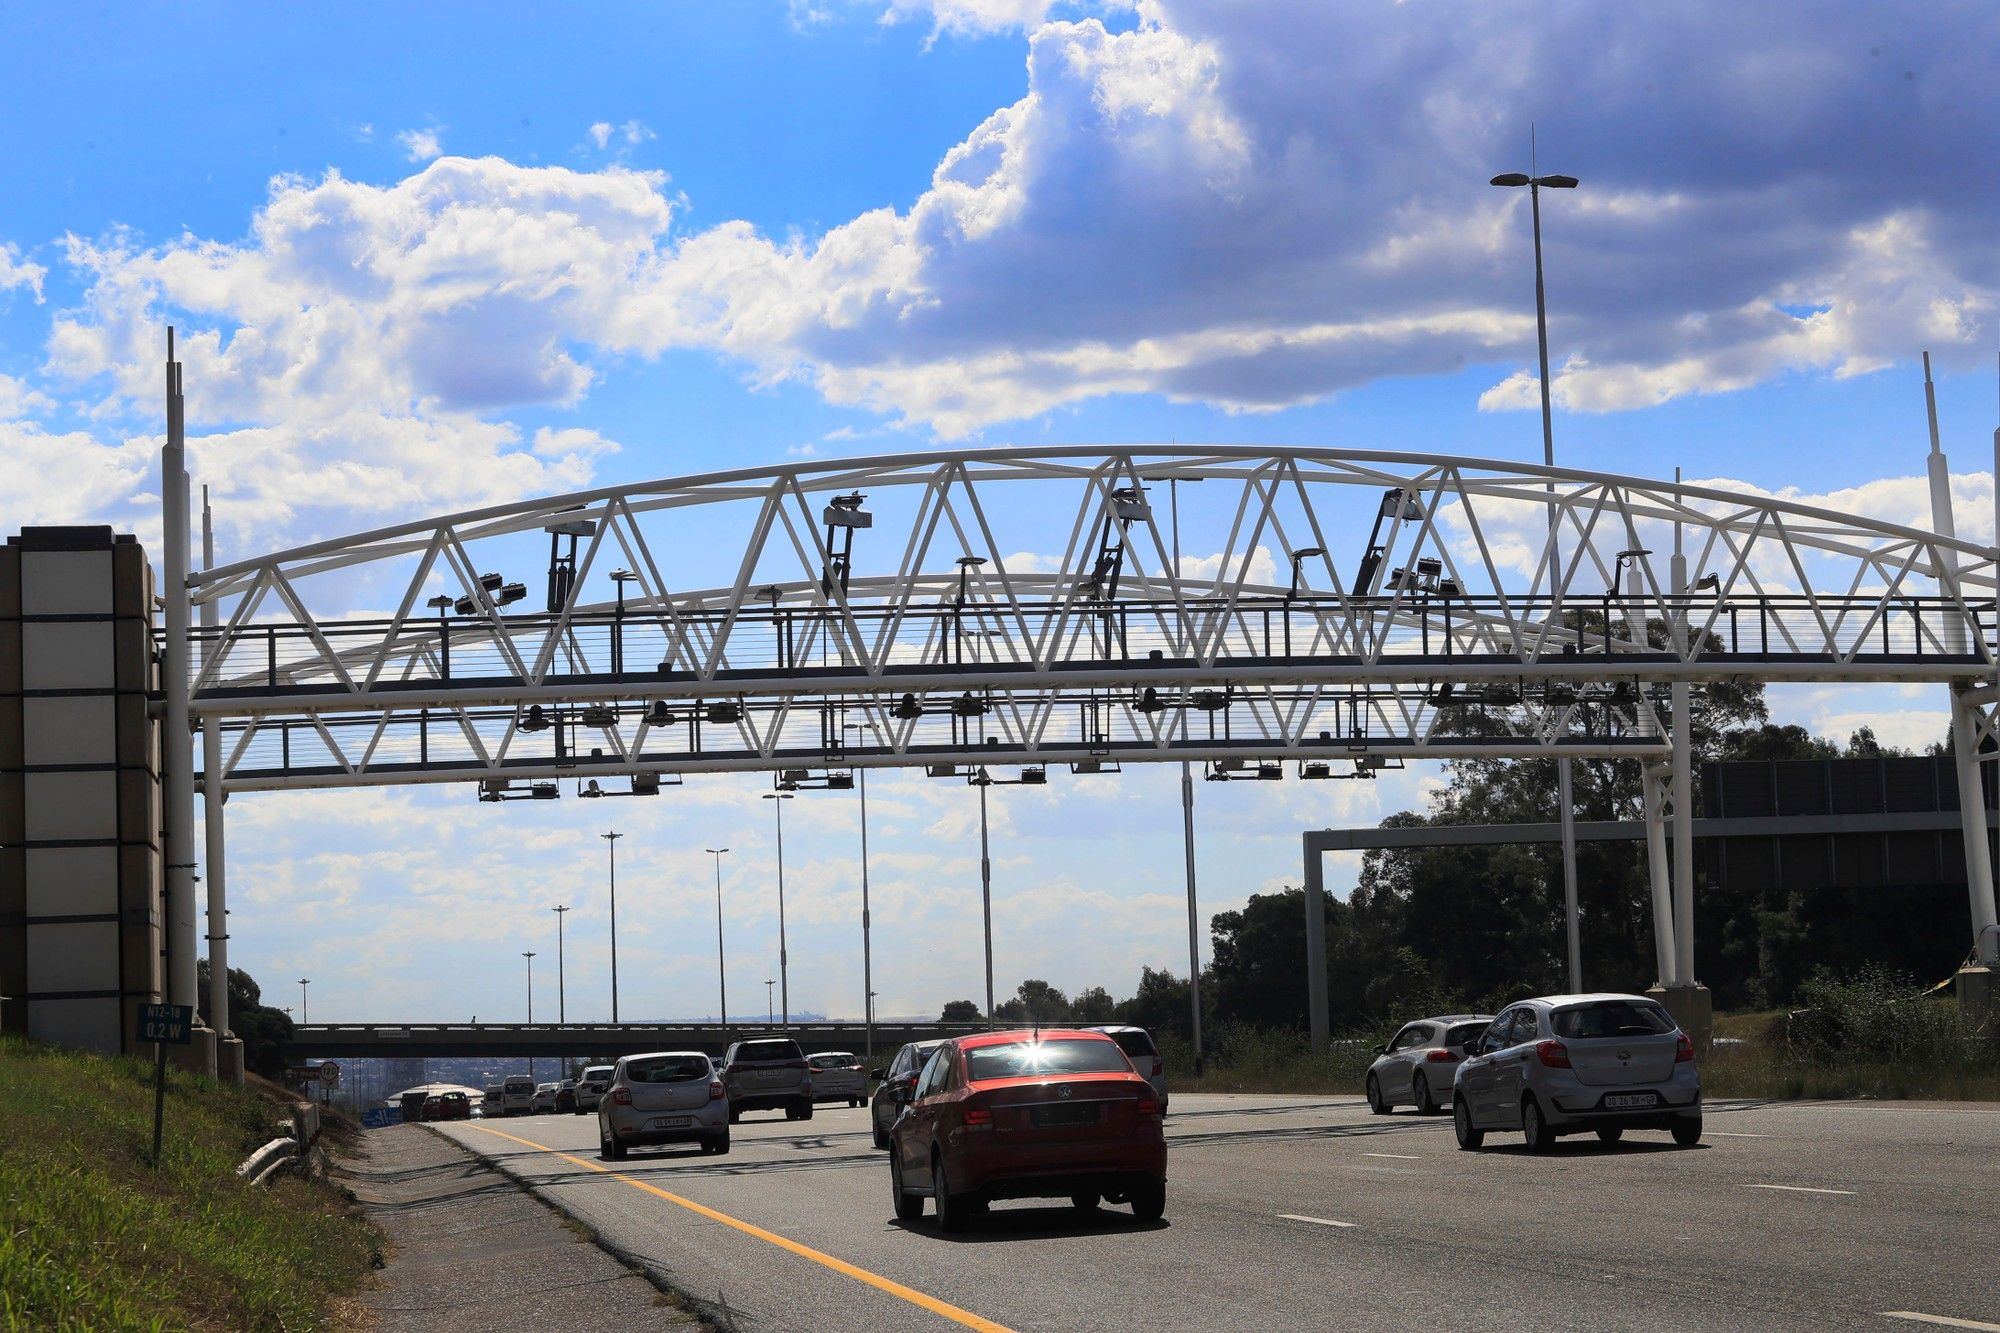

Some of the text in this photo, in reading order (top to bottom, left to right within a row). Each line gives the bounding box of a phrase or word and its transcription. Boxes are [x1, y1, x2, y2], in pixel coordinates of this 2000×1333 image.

[147, 1005, 181, 1018] N12-18
[147, 1022, 182, 1040] 0.2 W
[323, 1067, 336, 1076] 120
